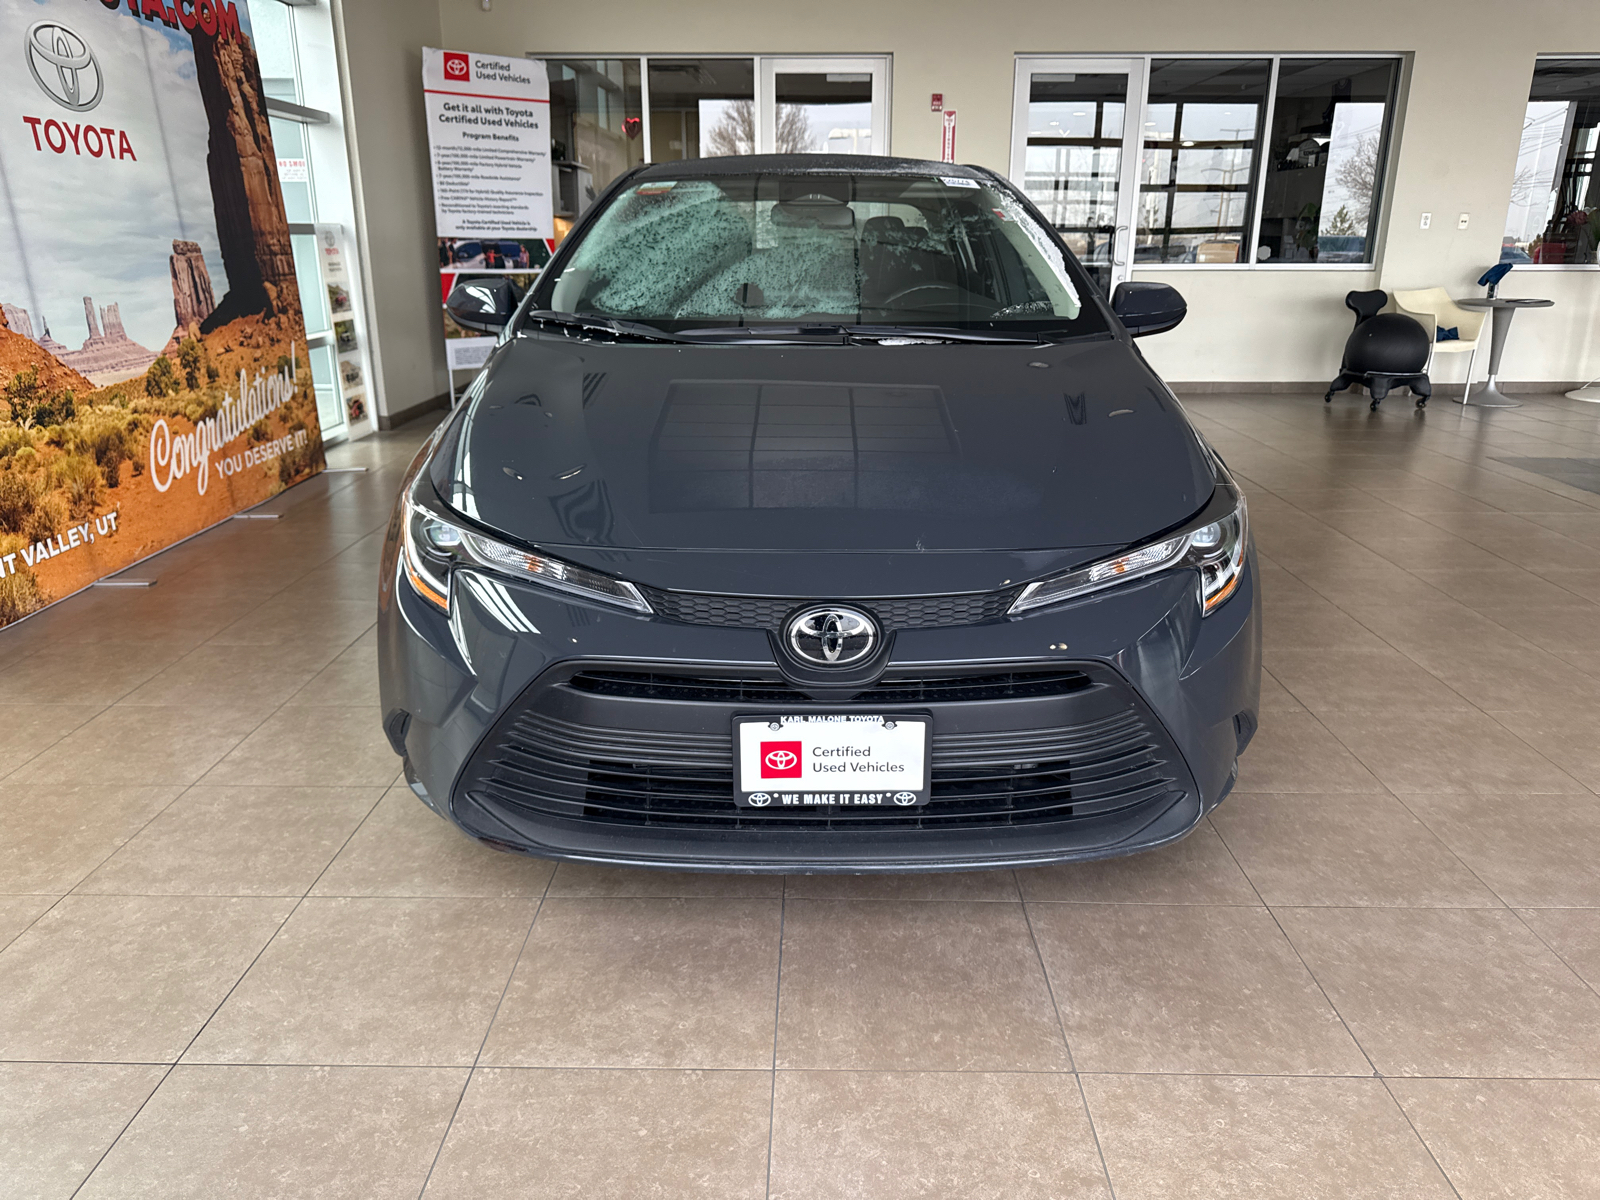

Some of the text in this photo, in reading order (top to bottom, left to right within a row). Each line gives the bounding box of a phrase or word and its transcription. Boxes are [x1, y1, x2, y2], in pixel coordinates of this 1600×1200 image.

[475, 60, 510, 72] Certified
[476, 71, 530, 84] Used Vehicles
[443, 102, 533, 118] Get it all with Toyota
[438, 114, 538, 129] Certified Used Vehicles
[23, 115, 138, 162] TOYOTA
[462, 132, 519, 142] Program Benefits
[150, 340, 298, 496] Congratulations!
[215, 429, 308, 479] YOU DESERVE IT!
[20, 522, 94, 567] VALLEY,
[96, 512, 117, 536] UT
[780, 715, 884, 724] KARL MALONE TOYOTA
[812, 746, 871, 757] Certified
[812, 762, 904, 772] Used Vehicles
[782, 794, 883, 804] WE MAKE IT EASY
